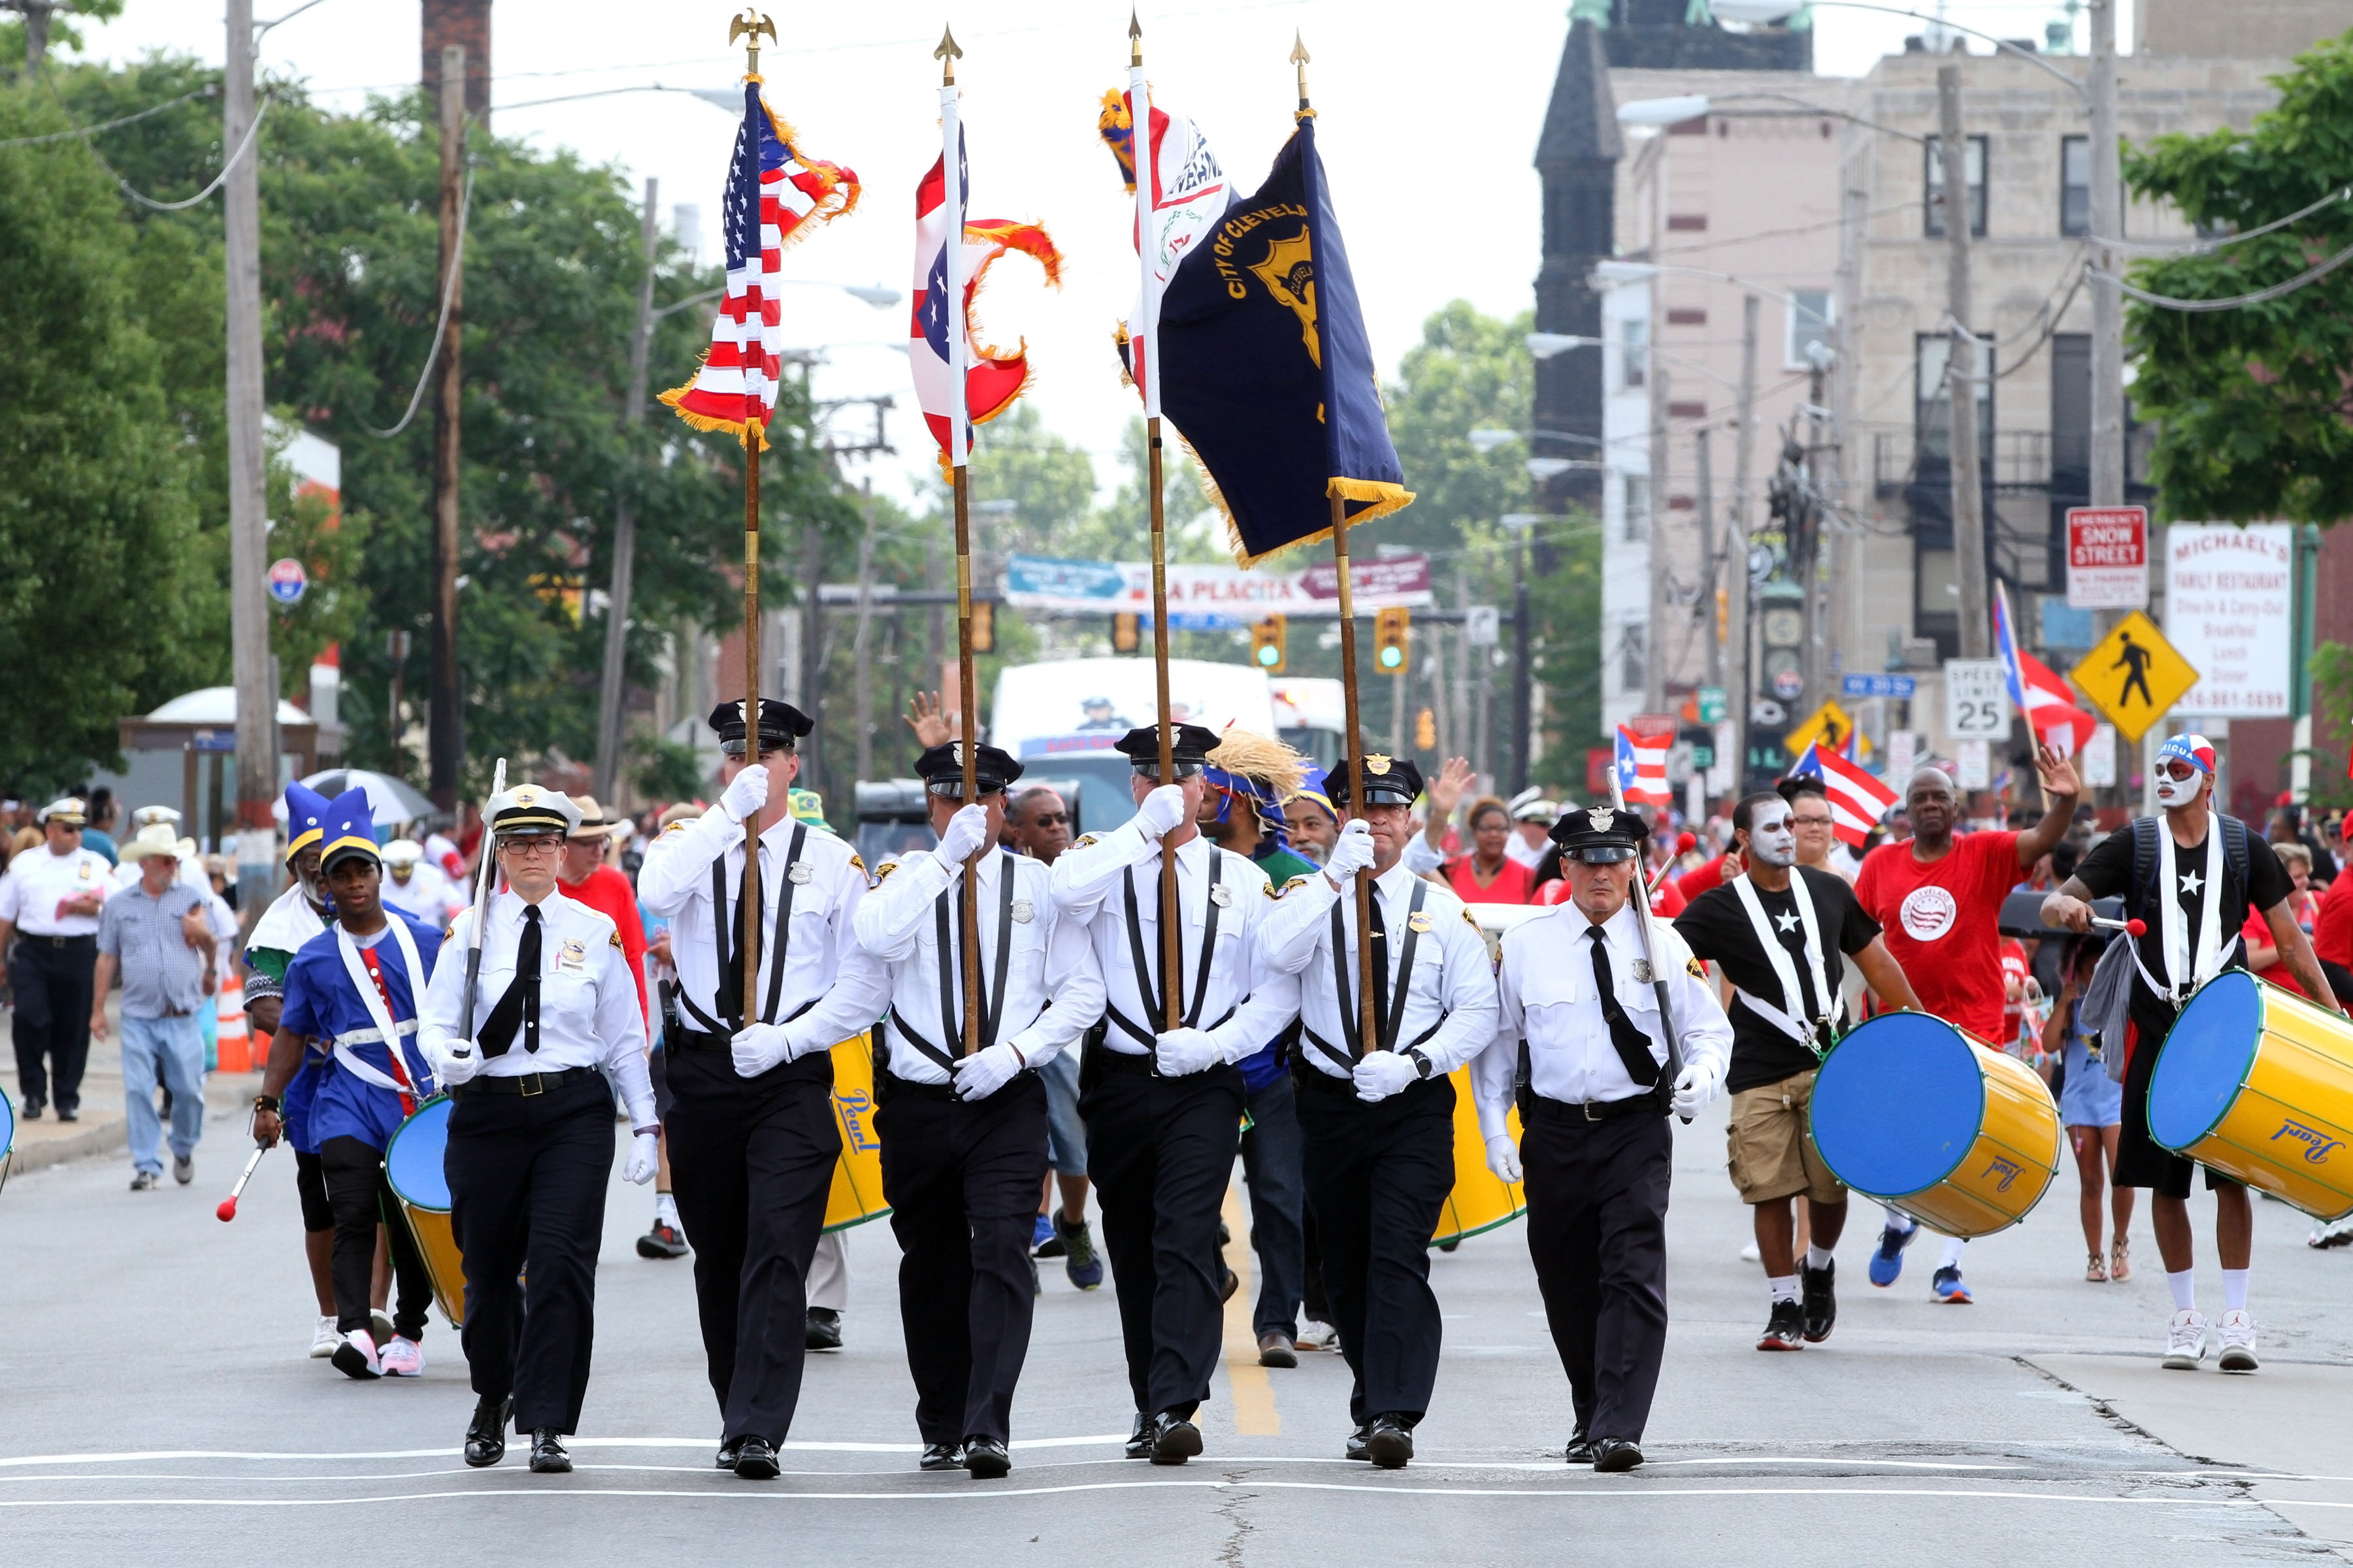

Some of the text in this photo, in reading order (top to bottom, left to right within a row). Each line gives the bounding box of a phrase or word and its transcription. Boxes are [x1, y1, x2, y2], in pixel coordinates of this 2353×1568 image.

[1213, 232, 1234, 256] OF
[1214, 257, 1247, 299] CITY
[2081, 525, 2133, 545] SNOW
[2075, 545, 2139, 565] STREET
[2175, 534, 2289, 563] MICHAEL'S
[1953, 668, 2005, 681] SPEED
[1954, 684, 1999, 698] LIMIT
[1958, 700, 1999, 730] 25
[1911, 888, 1950, 902] CLEVELAND
[833, 1086, 881, 1152] Pearl
[2270, 1123, 2346, 1164] Pearl
[1981, 1158, 2026, 1193] Pearl
